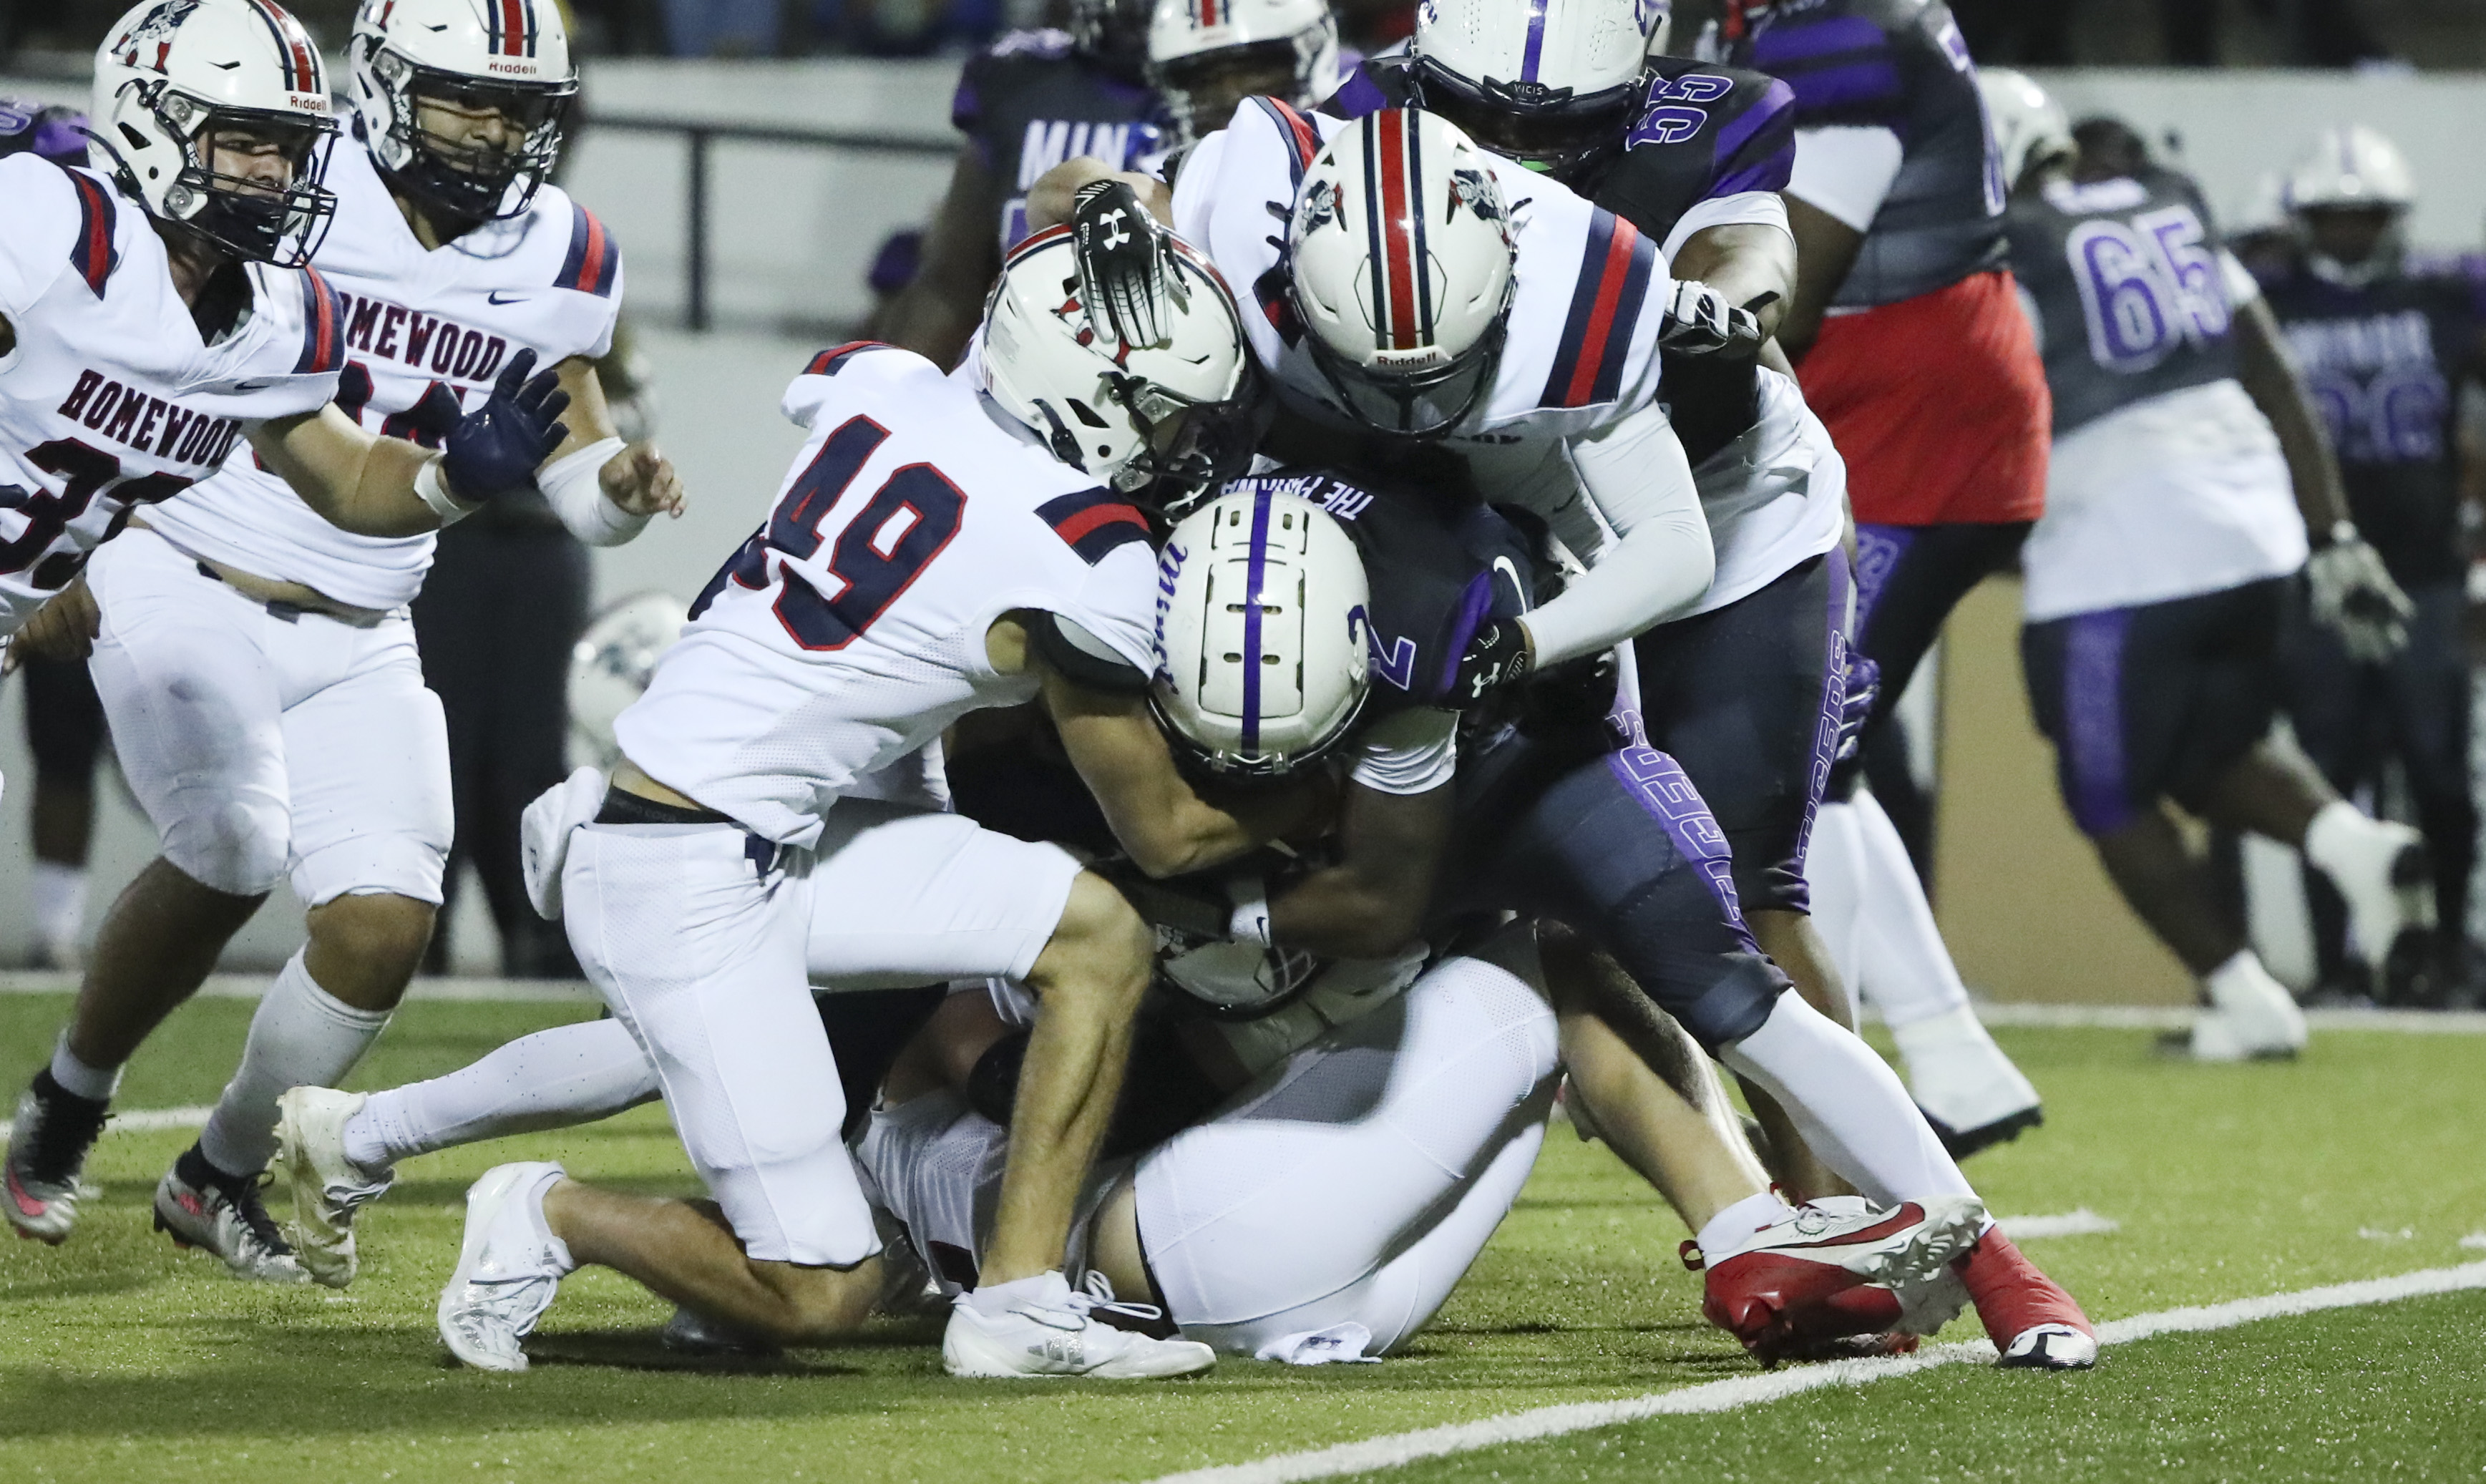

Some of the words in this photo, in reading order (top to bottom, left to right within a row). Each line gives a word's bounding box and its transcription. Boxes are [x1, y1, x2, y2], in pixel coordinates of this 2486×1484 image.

[489, 61, 537, 75] Riddell
[1513, 84, 1543, 96] VICIS
[291, 94, 327, 111] Riddell
[1626, 74, 1734, 152] 55
[2065, 204, 2230, 374] 65
[57, 368, 243, 468] HOMEWOOD
[1312, 481, 1375, 521] THE
[732, 413, 969, 650] 49
